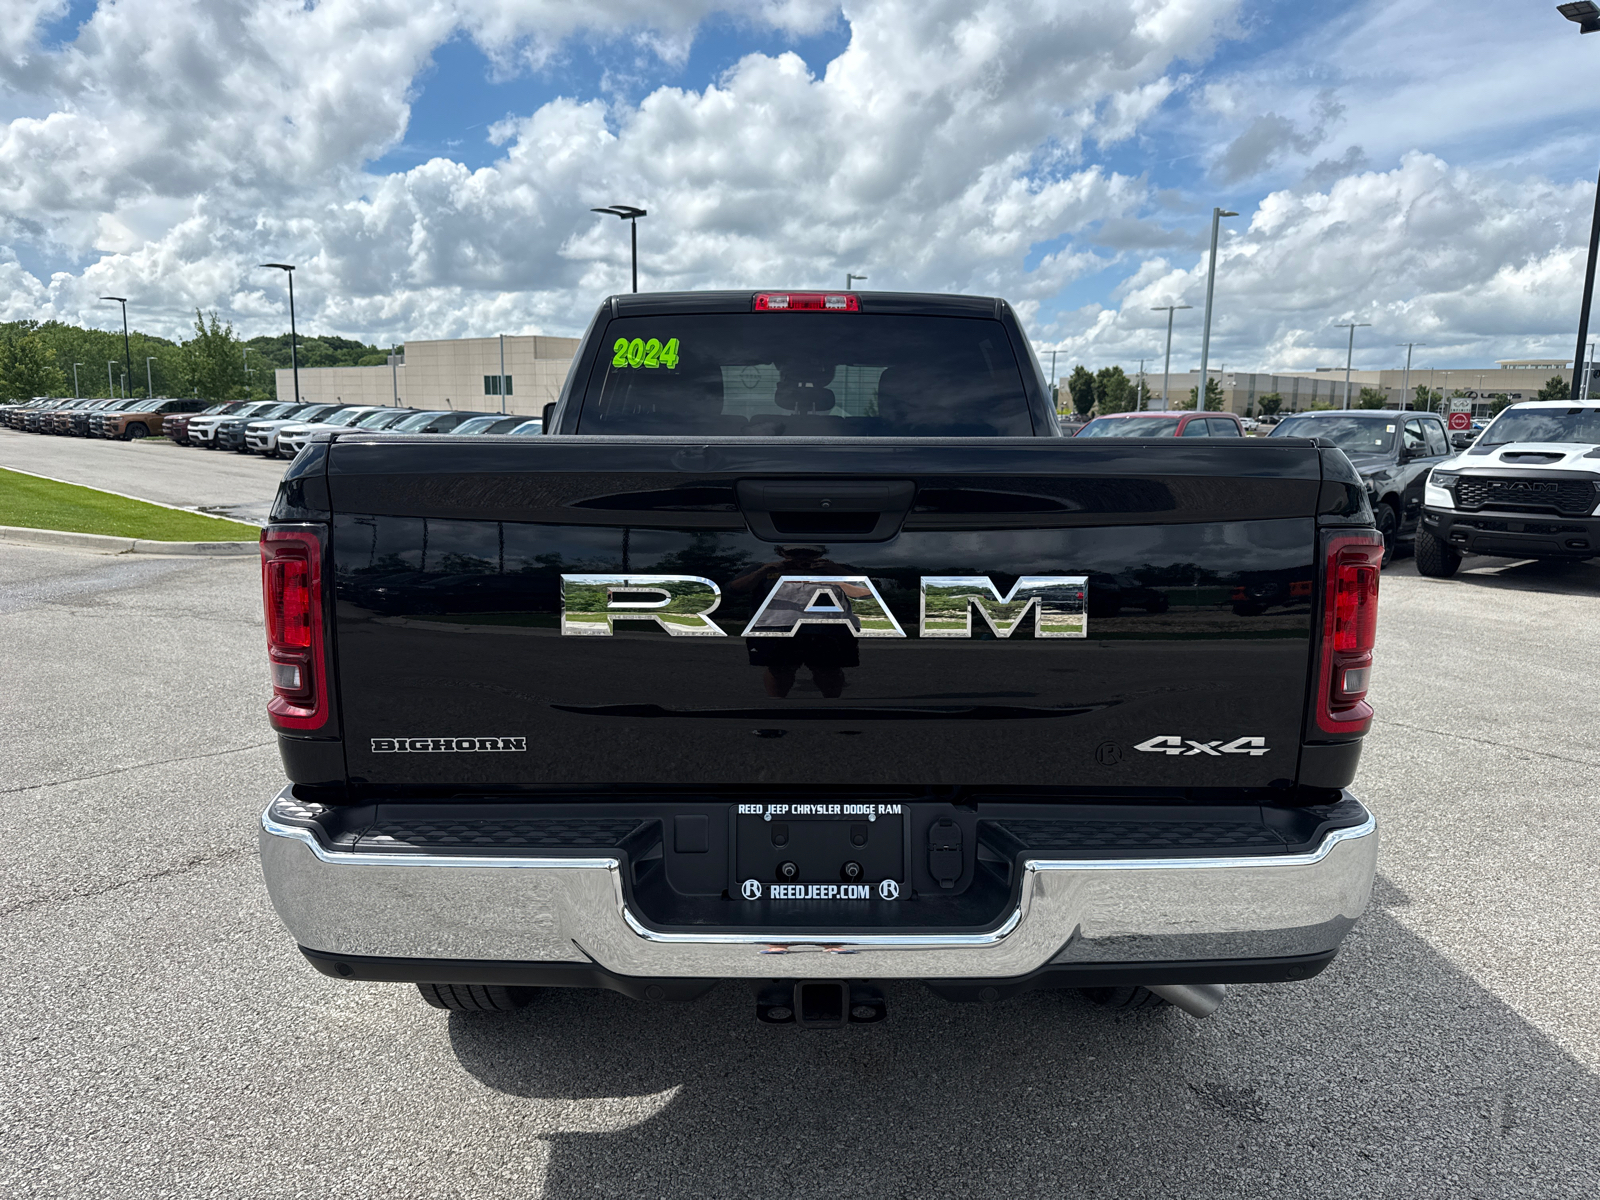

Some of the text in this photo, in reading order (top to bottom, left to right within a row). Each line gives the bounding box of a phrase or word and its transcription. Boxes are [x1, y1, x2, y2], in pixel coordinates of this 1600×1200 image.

[612, 338, 680, 369] 2024
[1486, 480, 1559, 492] RAM
[560, 573, 1090, 638] RAM
[371, 737, 526, 752] BIGHORN
[738, 804, 902, 814] REED JEEP CHRYSLER DODGE RAM
[770, 885, 870, 899] REEDJEEP.COM
